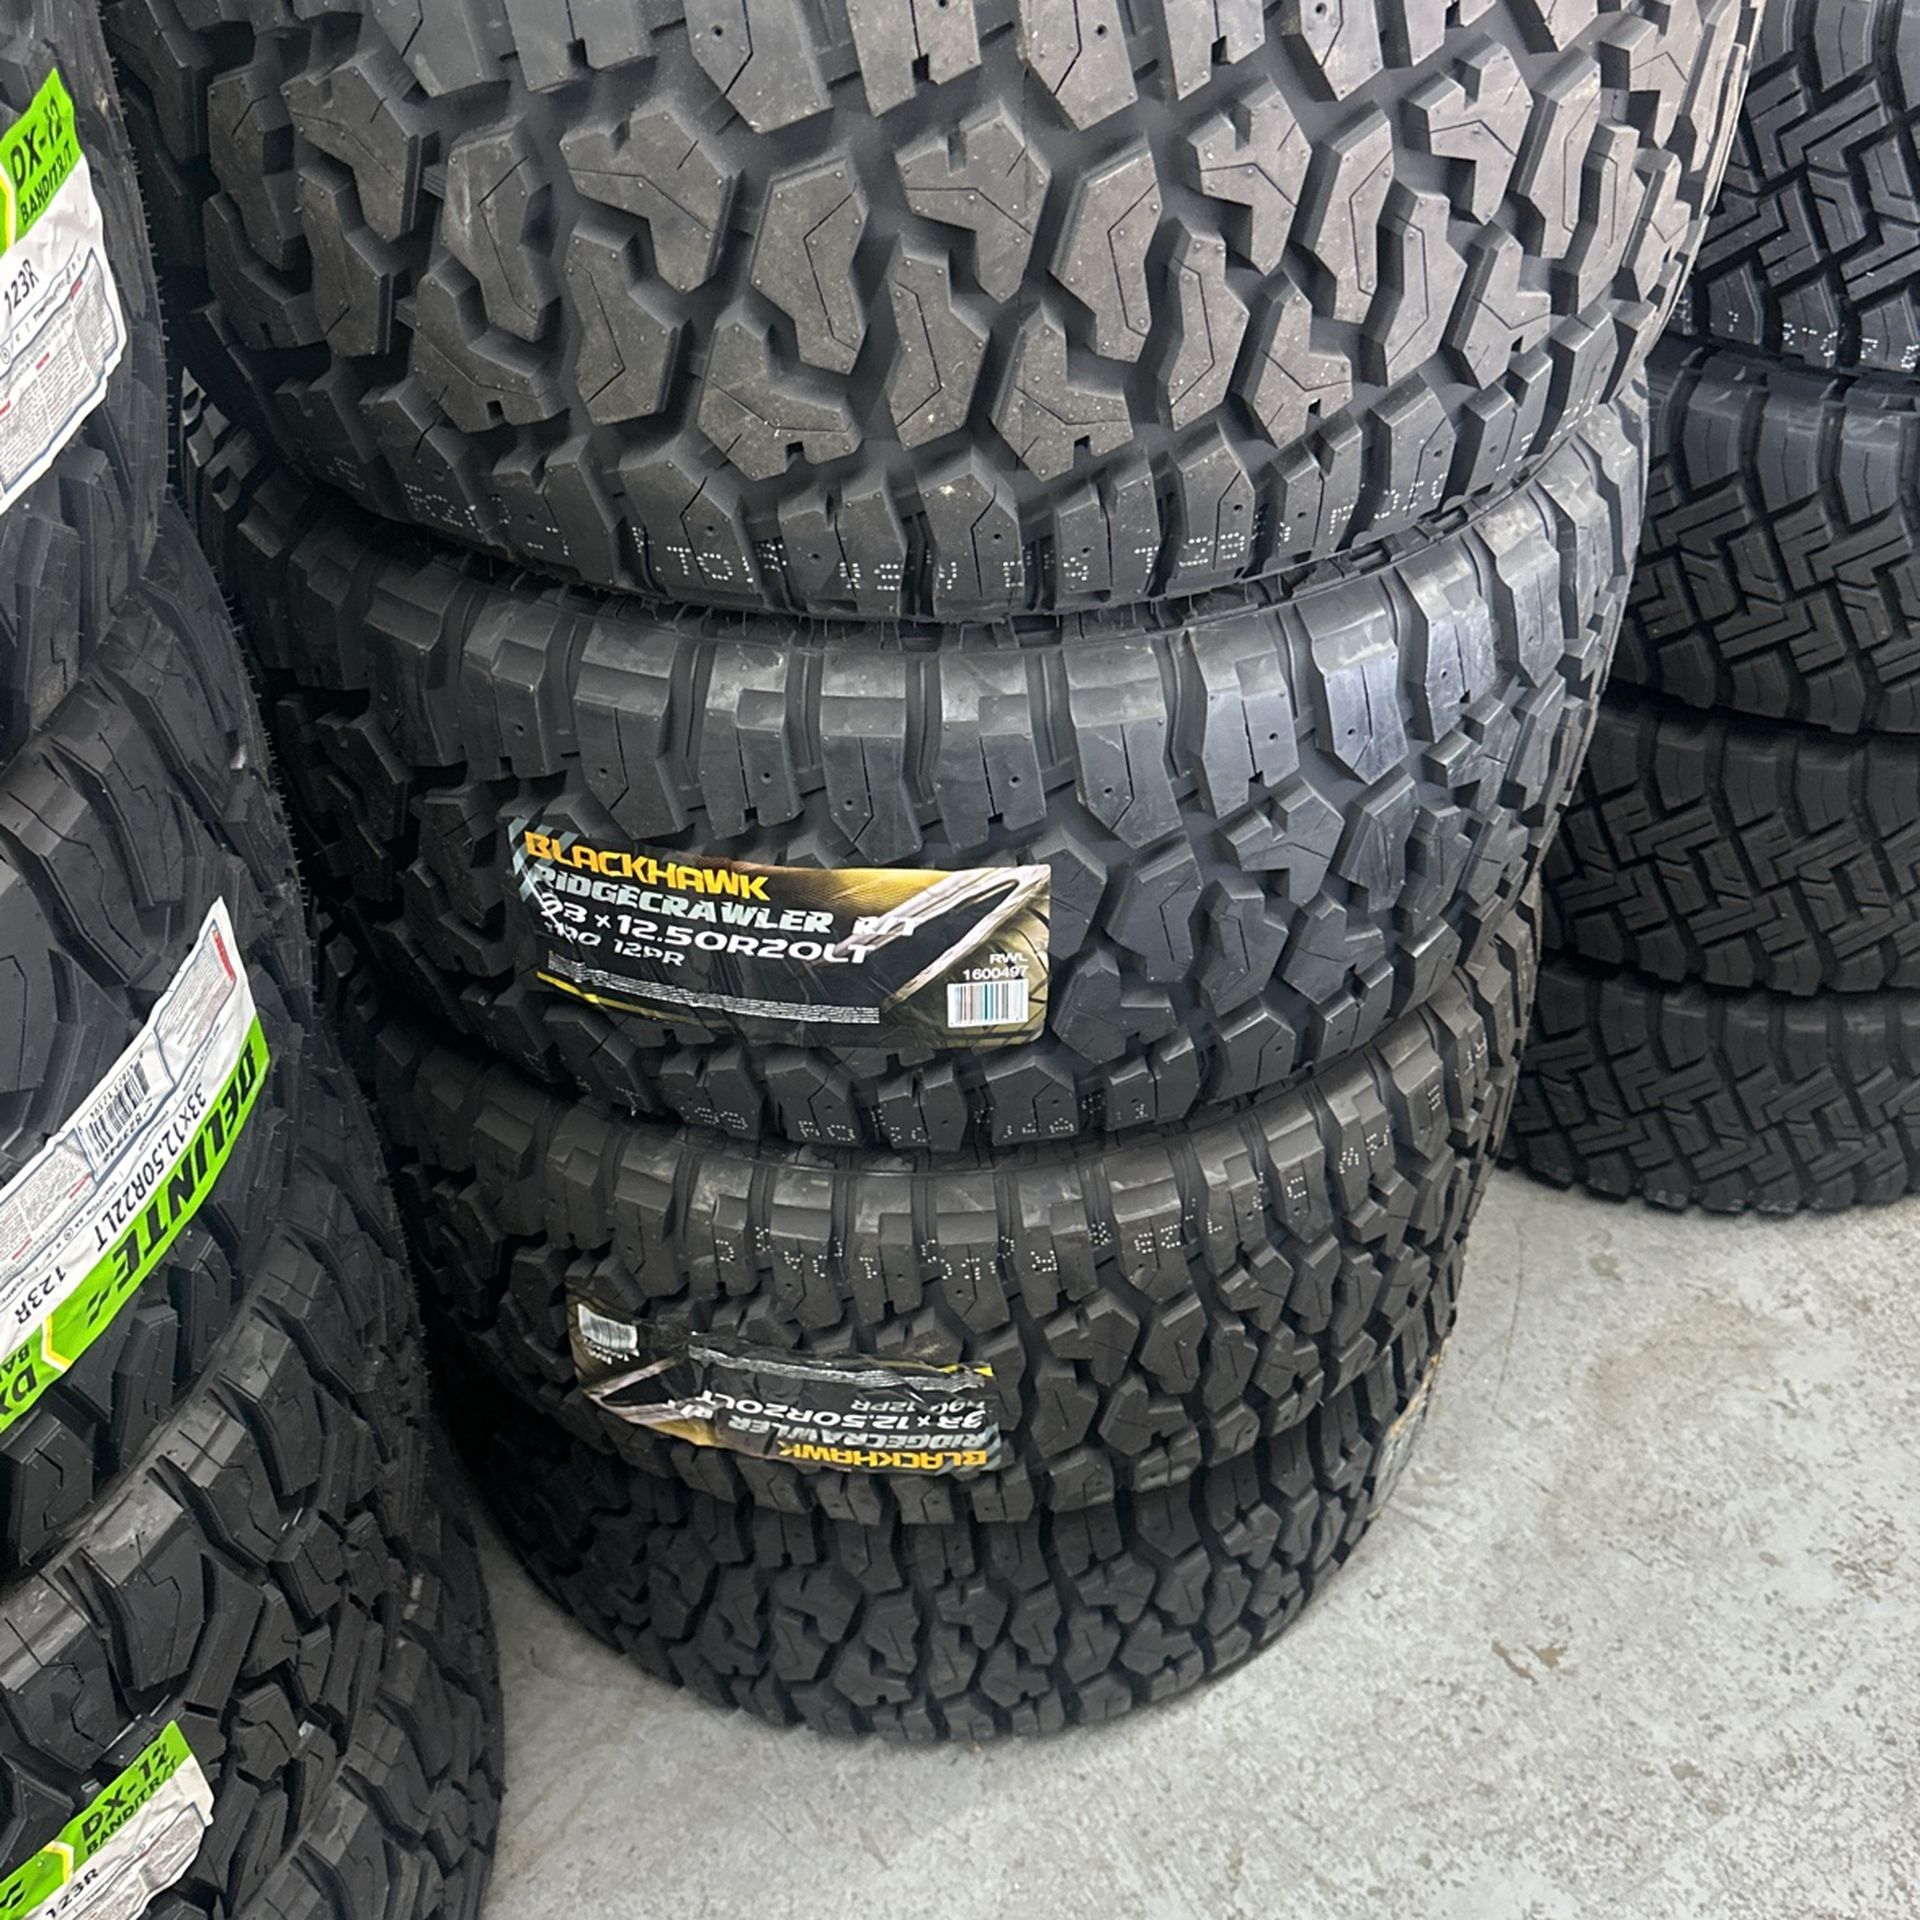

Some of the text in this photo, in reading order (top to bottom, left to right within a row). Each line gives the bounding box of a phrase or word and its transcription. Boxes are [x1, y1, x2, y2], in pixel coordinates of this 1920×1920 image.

[10, 95, 63, 190] DX-12
[4, 258, 40, 316] 123R
[524, 831, 770, 901] BLACKHAWK
[533, 863, 834, 934] RIDGECRAWLER
[613, 938, 685, 966] 12PR
[851, 915, 928, 937] R/T
[963, 965, 1029, 981] 1600497
[990, 952, 1028, 965] RWL
[96, 1082, 206, 1252] 33x12.50R22LT
[112, 1040, 257, 1294] DELINTE
[15, 1265, 67, 1324] 123R
[728, 1415, 986, 1449] RIDGECRAWLER
[850, 1398, 916, 1413] 12PR
[777, 1440, 987, 1470] BLACKHAWK
[82, 1743, 168, 1842] DX-12
[45, 1868, 99, 1919] 123R
